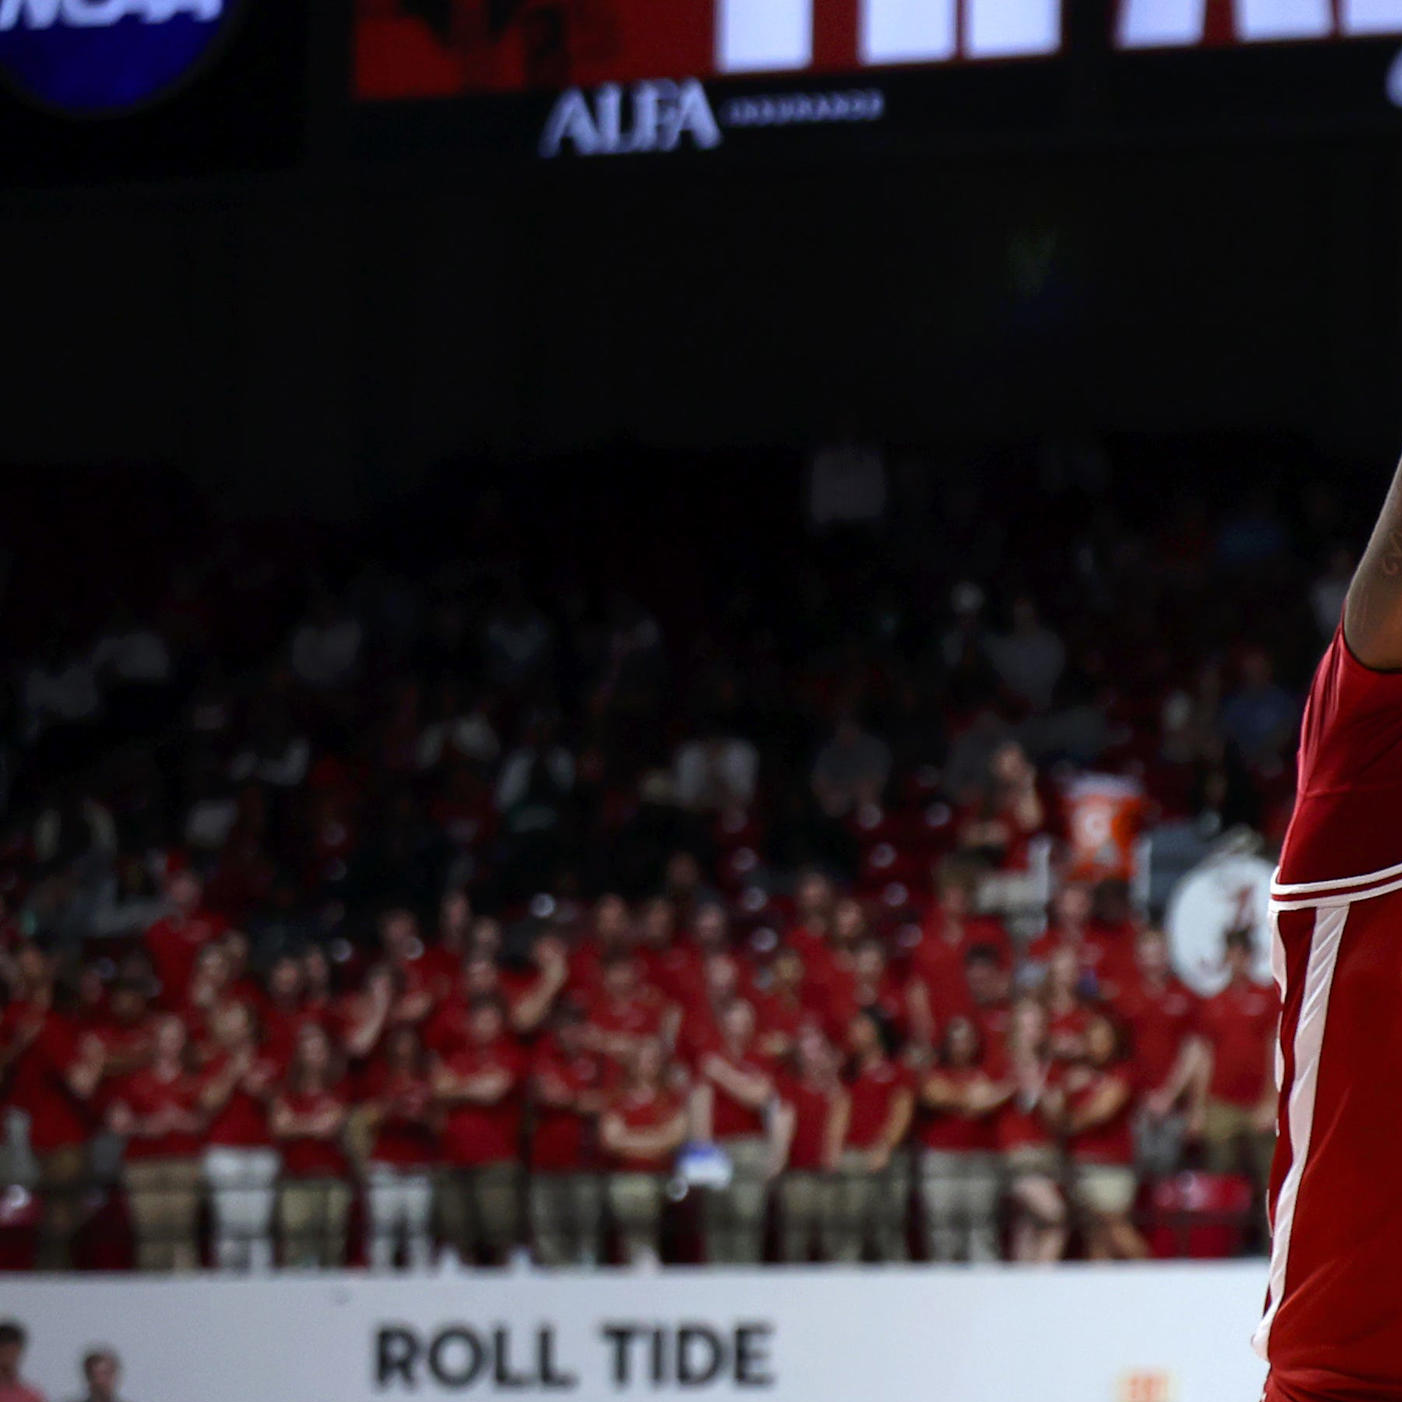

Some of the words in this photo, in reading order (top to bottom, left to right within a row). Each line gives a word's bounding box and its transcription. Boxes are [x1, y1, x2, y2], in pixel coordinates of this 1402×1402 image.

[540, 78, 722, 157] ALFA
[374, 1323, 577, 1391] ROLL
[601, 1322, 776, 1389] TIDE
